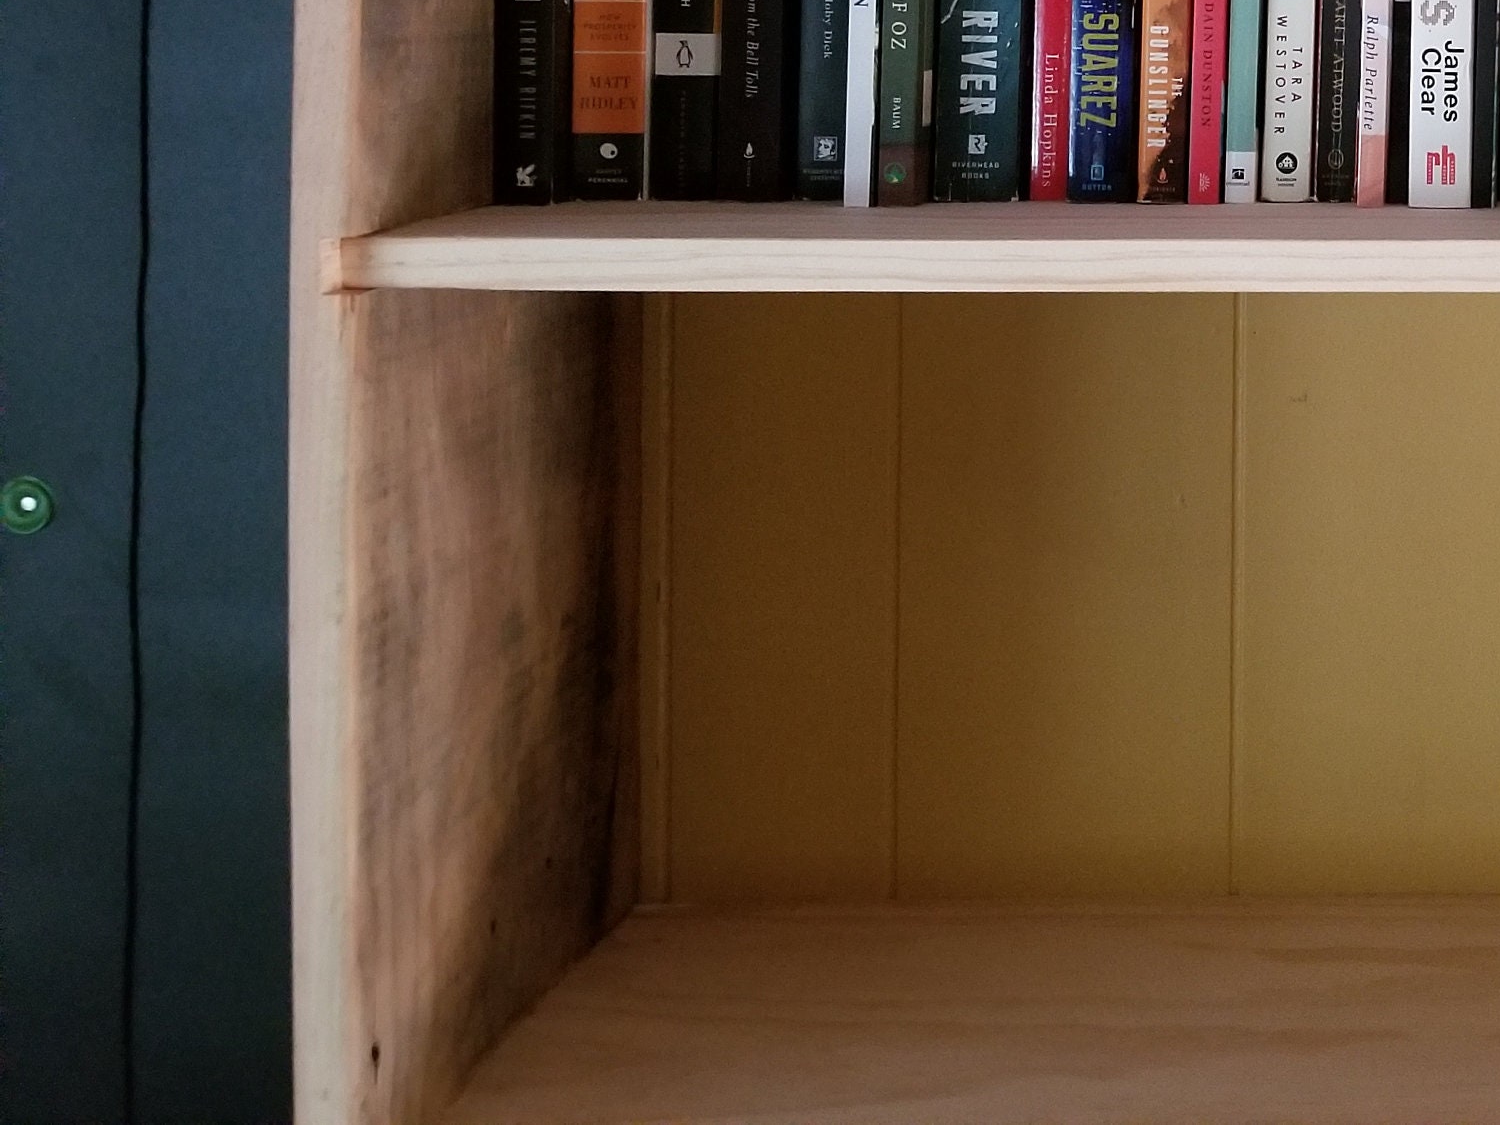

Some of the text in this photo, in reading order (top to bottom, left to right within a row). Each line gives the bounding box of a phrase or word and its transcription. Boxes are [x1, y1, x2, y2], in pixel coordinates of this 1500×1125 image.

[744, 41, 760, 66] Bell
[745, 17, 761, 37] the
[822, 30, 834, 60] Dick
[889, 20, 907, 51] OZ
[518, 19, 537, 140] JEREMY RIFKIN
[589, 75, 632, 90] MATT
[743, 70, 760, 99] Tolls
[959, 10, 999, 116] RIVER
[1080, 13, 1120, 128] SUAREZ
[1146, 25, 1170, 148] GUNSLINGER
[1172, 77, 1184, 98] THE
[1200, 2, 1216, 128] DAIN DUNSTON
[1273, 15, 1289, 135] WESTOVER
[1291, 46, 1304, 103] TARA
[1330, 53, 1345, 134] ATWOOD
[1362, 15, 1380, 131] Ralph Parlette
[1420, 47, 1442, 116] Clear
[1442, 39, 1465, 123] James
[580, 96, 638, 111] RIDLEY
[891, 97, 903, 130] BAUM
[1039, 52, 1061, 188] Linda Hopkins
